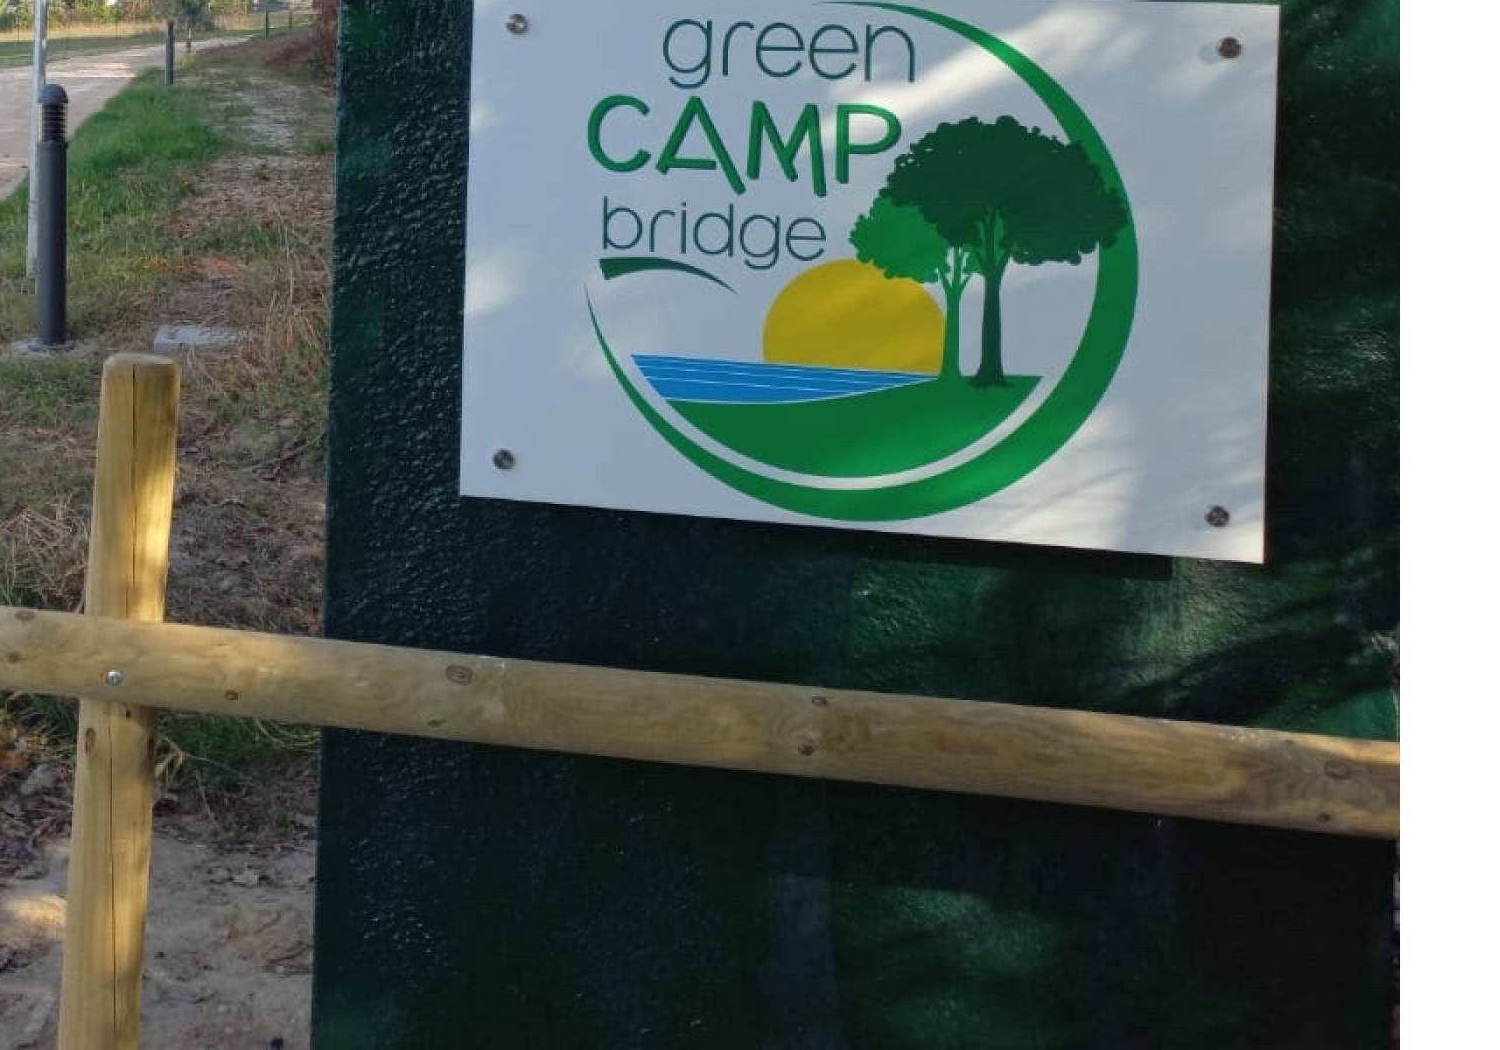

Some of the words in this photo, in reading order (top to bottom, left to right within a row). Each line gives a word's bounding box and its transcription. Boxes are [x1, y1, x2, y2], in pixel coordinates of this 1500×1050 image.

[662, 17, 915, 90] green
[587, 94, 903, 197] CAMP
[602, 196, 827, 270] bridge
